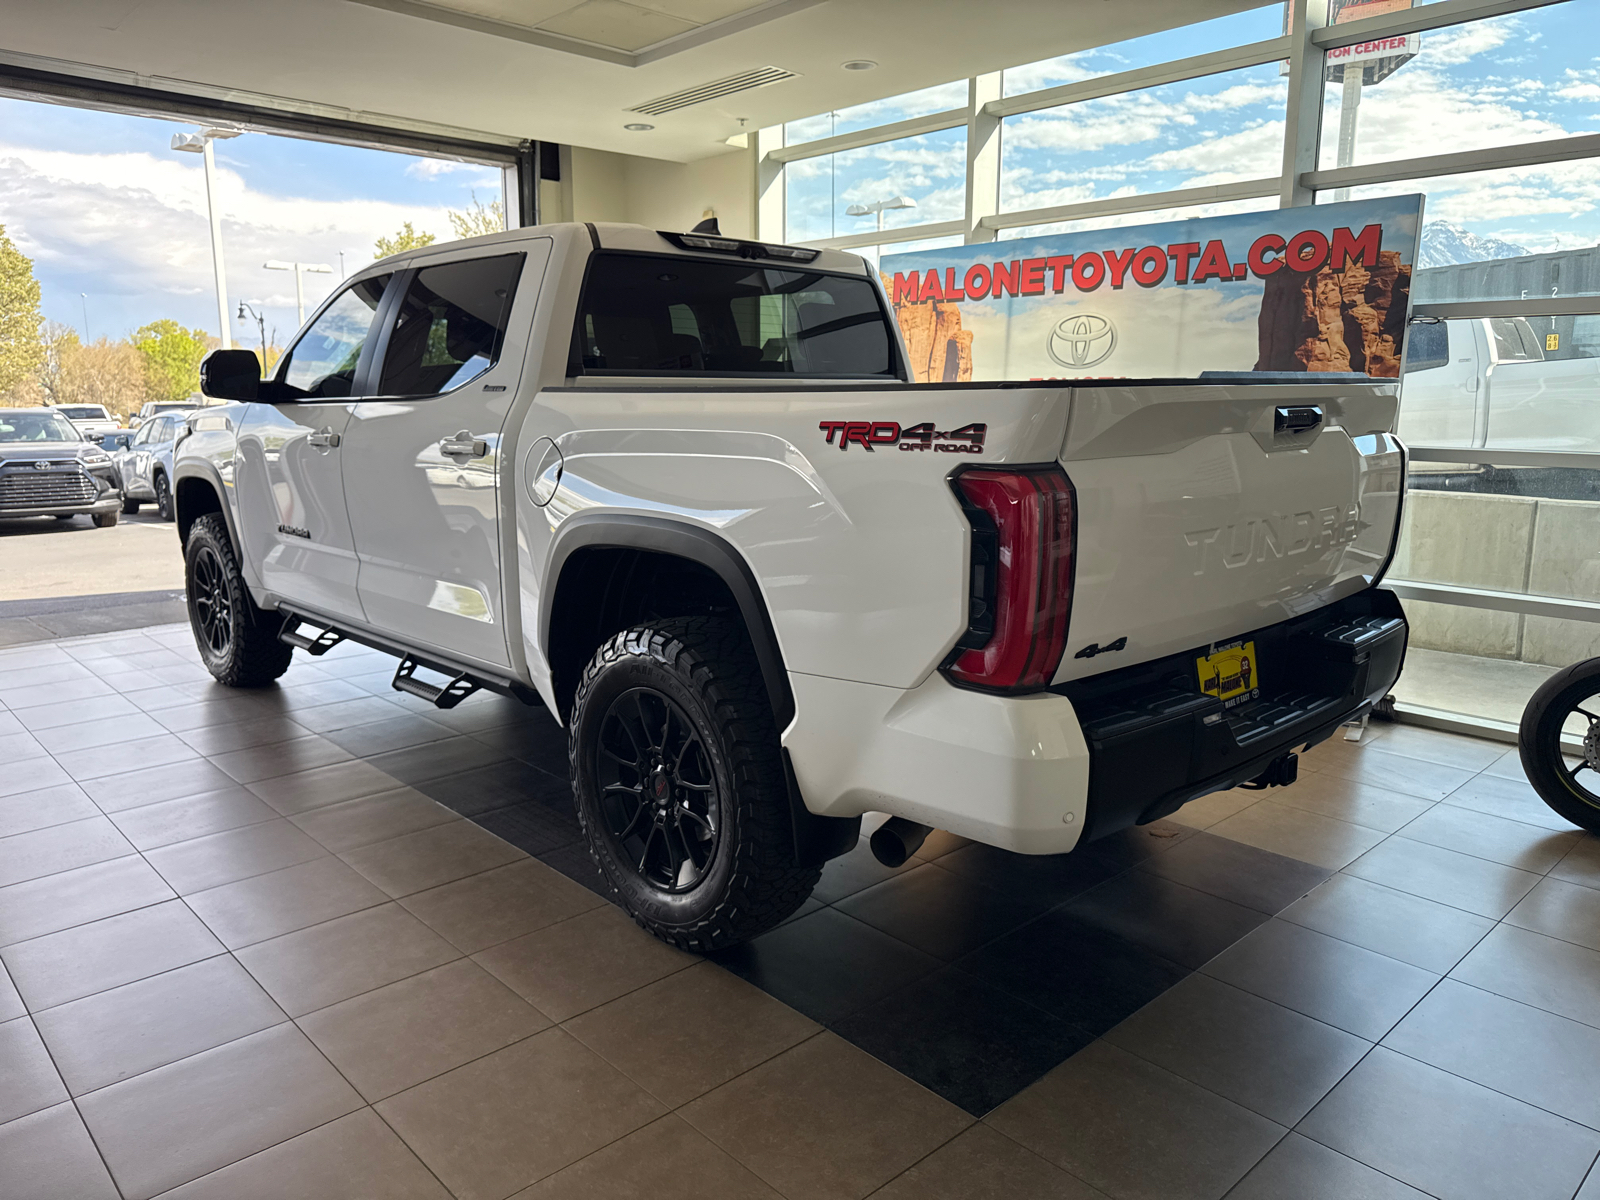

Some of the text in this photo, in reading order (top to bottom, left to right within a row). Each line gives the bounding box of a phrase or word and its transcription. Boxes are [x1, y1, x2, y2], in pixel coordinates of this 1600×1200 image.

[1354, 37, 1407, 55] CENTER
[893, 223, 1383, 302] MALONETOYOTA.COM
[1551, 287, 1558, 298] 2
[819, 421, 901, 452] TRD
[899, 443, 984, 454] OFF ROAD
[1184, 501, 1361, 576] TUNDRA
[1242, 660, 1249, 670] 32
[1241, 693, 1250, 702] EASY
